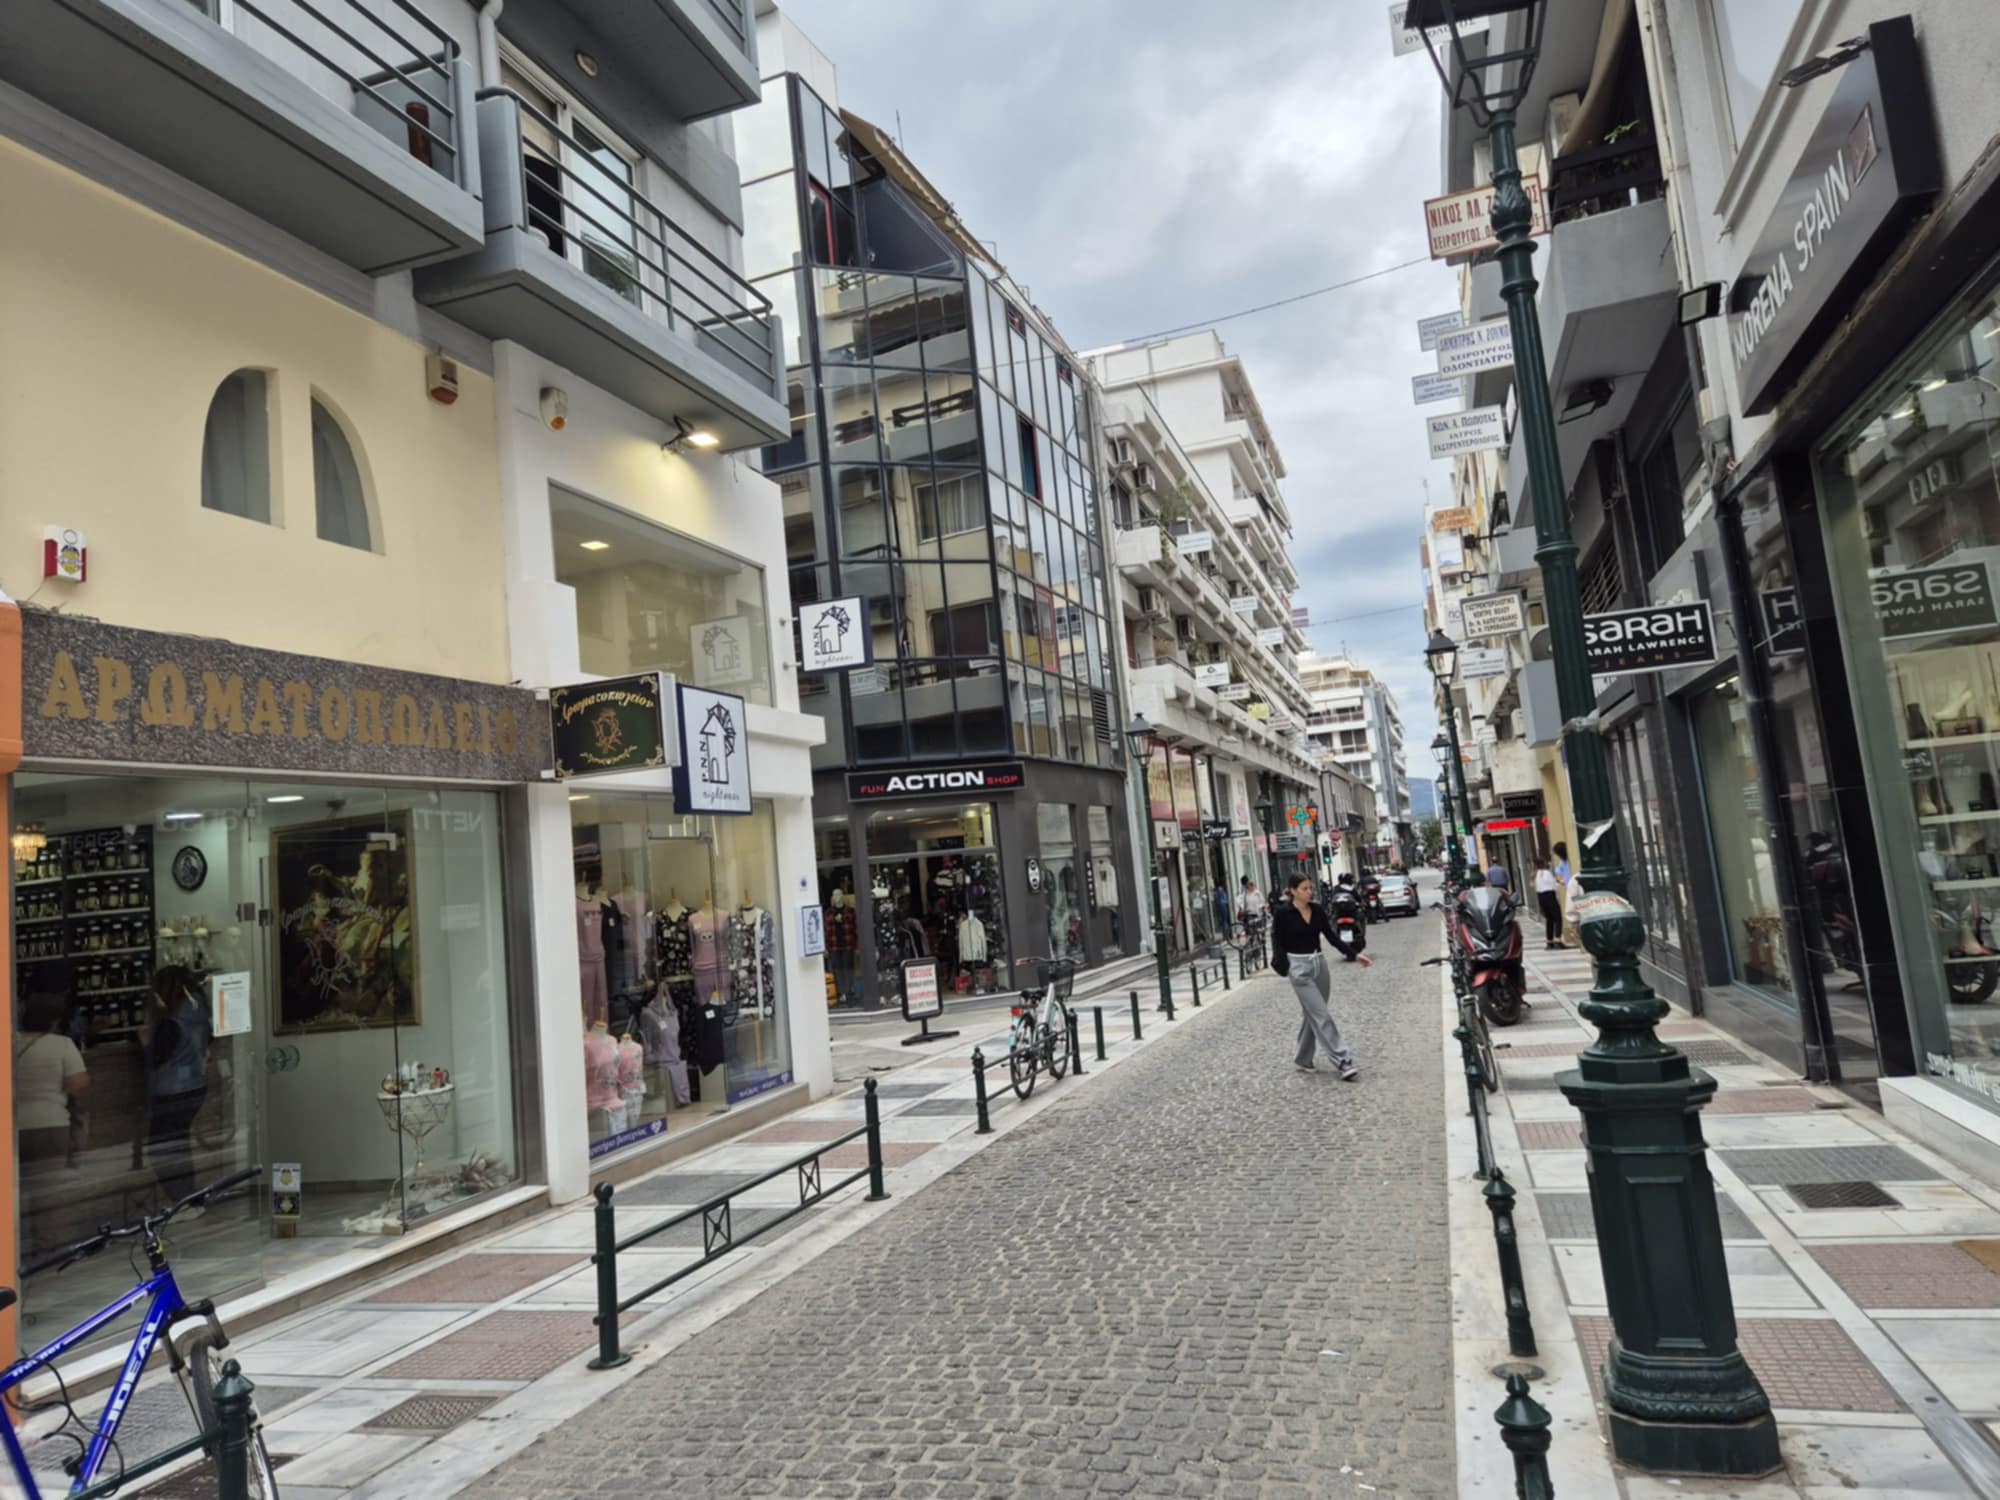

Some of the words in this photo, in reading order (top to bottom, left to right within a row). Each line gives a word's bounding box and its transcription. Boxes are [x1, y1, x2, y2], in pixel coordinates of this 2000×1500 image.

[1428, 203, 1462, 228] ΝΙΚΟΣ
[1732, 252, 1793, 369] MORENA
[1794, 149, 1849, 272] SPAIN
[1442, 352, 1513, 373] ΟΔΟΝΤΙΑΤΡΟ
[1587, 646, 1623, 657] ARAH
[1628, 635, 1705, 652] LAWRENCE
[40, 650, 544, 761] ΑΡΩΜΑΤΟΠΩΛΕΙΟ
[860, 785, 885, 794] FUN
[886, 770, 984, 793] ACTION
[987, 775, 1019, 785] SHOP
[108, 1322, 158, 1422] IDEAL
